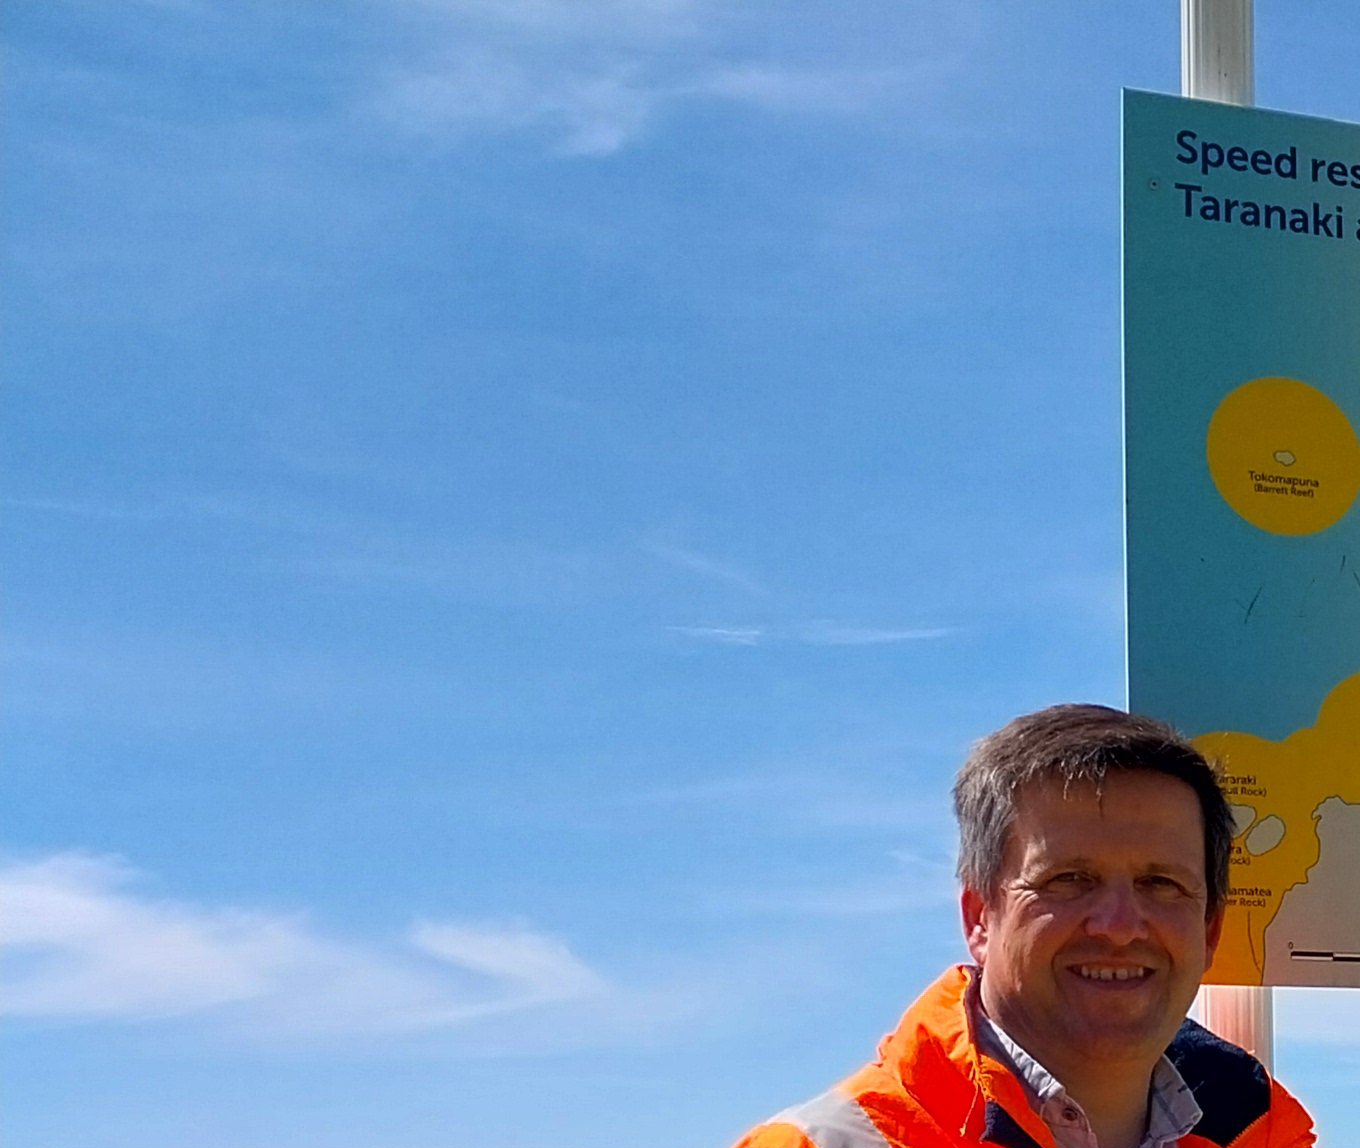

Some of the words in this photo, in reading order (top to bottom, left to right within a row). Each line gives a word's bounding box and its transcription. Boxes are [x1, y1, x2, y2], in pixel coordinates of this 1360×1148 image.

[1174, 129, 1297, 181] Speed
[1174, 182, 1344, 240] Taranaki
[1248, 470, 1319, 487] Tokomapuna
[1254, 483, 1288, 495] (Barrett
[1240, 786, 1267, 798] Rock)
[1239, 897, 1266, 908] Rock)
[1288, 942, 1294, 950] 0
